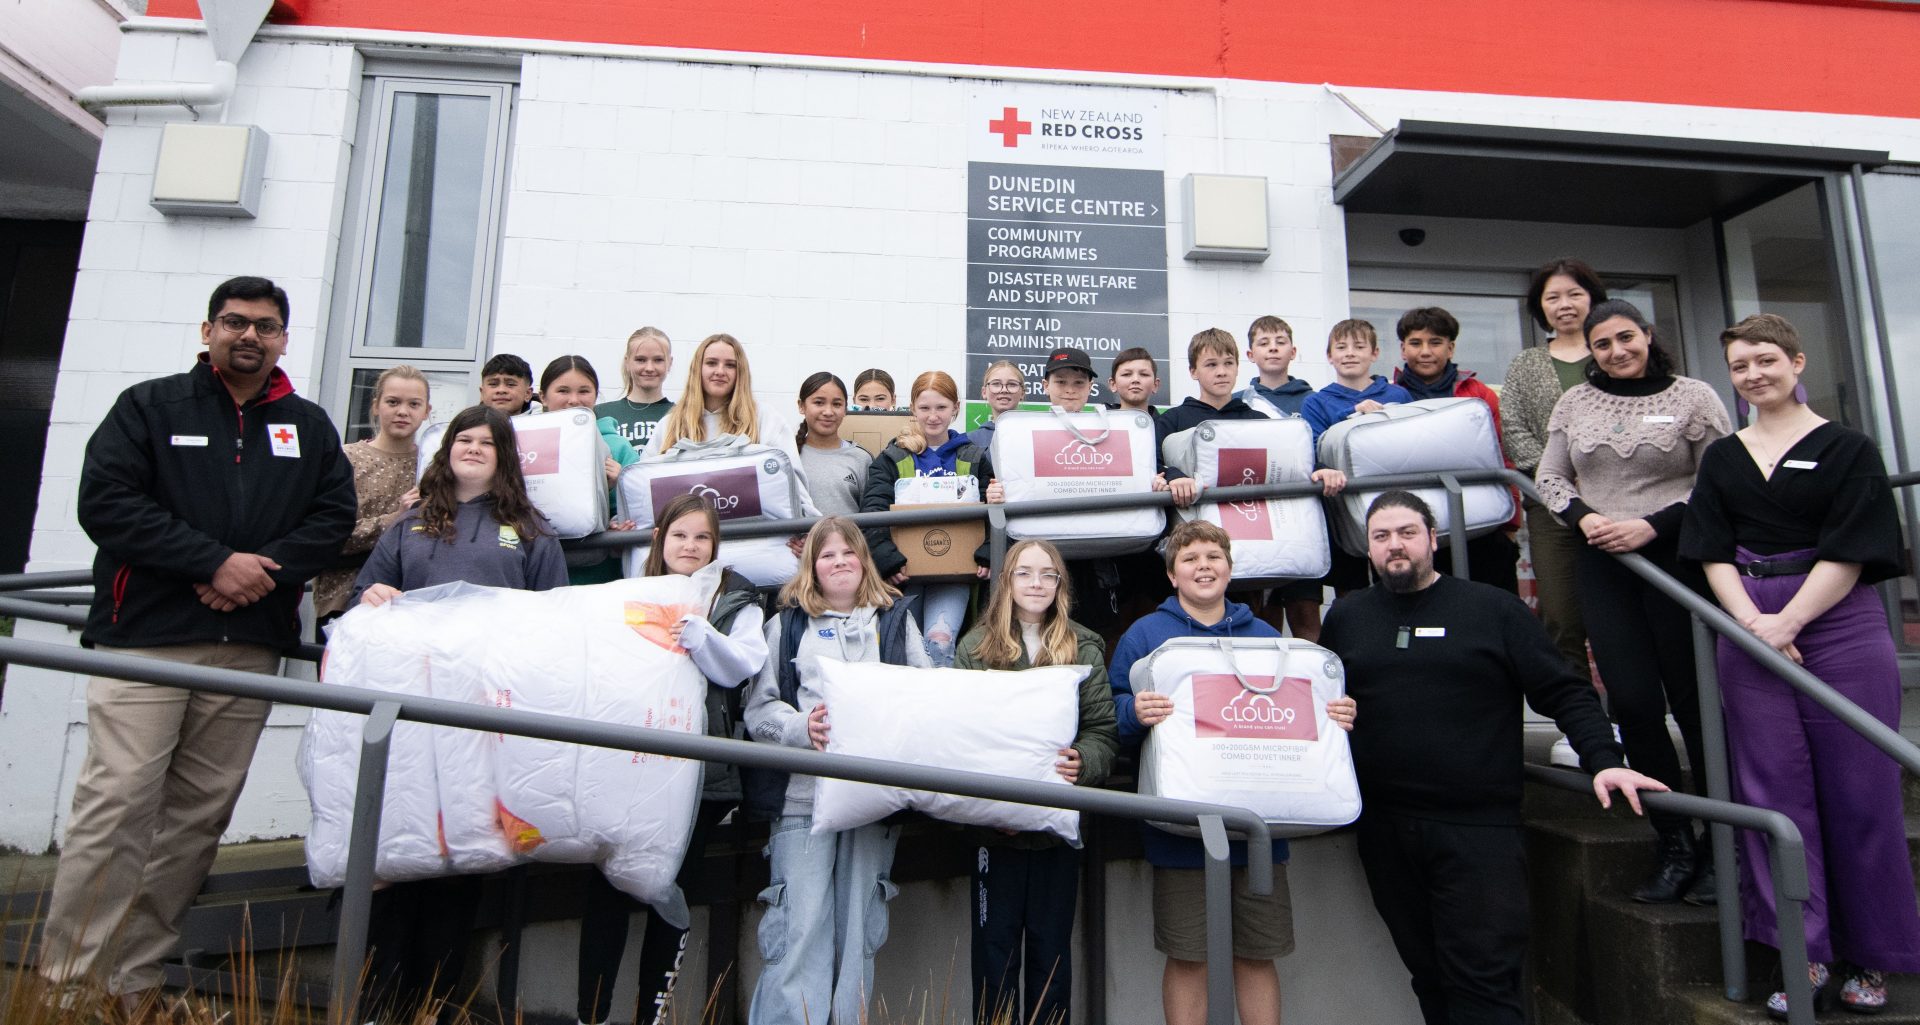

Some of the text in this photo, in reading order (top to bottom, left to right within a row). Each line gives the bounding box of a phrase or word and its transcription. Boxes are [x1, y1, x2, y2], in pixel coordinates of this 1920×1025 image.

[1041, 108, 1143, 124] NEW ZEALAND
[1042, 122, 1143, 141] RED CROSS
[988, 175, 1075, 194] DUNEDIN
[987, 195, 1146, 217] SERVICE CENTRE
[987, 227, 1083, 244] COMMUNITY
[987, 244, 1098, 261] PROGRAMMES
[988, 271, 1138, 290] DISASTER WELFARE
[987, 289, 1099, 305] AND SUPPORT
[987, 316, 1061, 332] FIRST AID
[987, 334, 1121, 351] ADMINISTRATION
[1054, 452, 1113, 465] CLOUD9
[1242, 467, 1258, 522] CLOD9
[1220, 705, 1296, 724] CLOUD9
[1220, 752, 1302, 762] COMBO DUVET INNER
